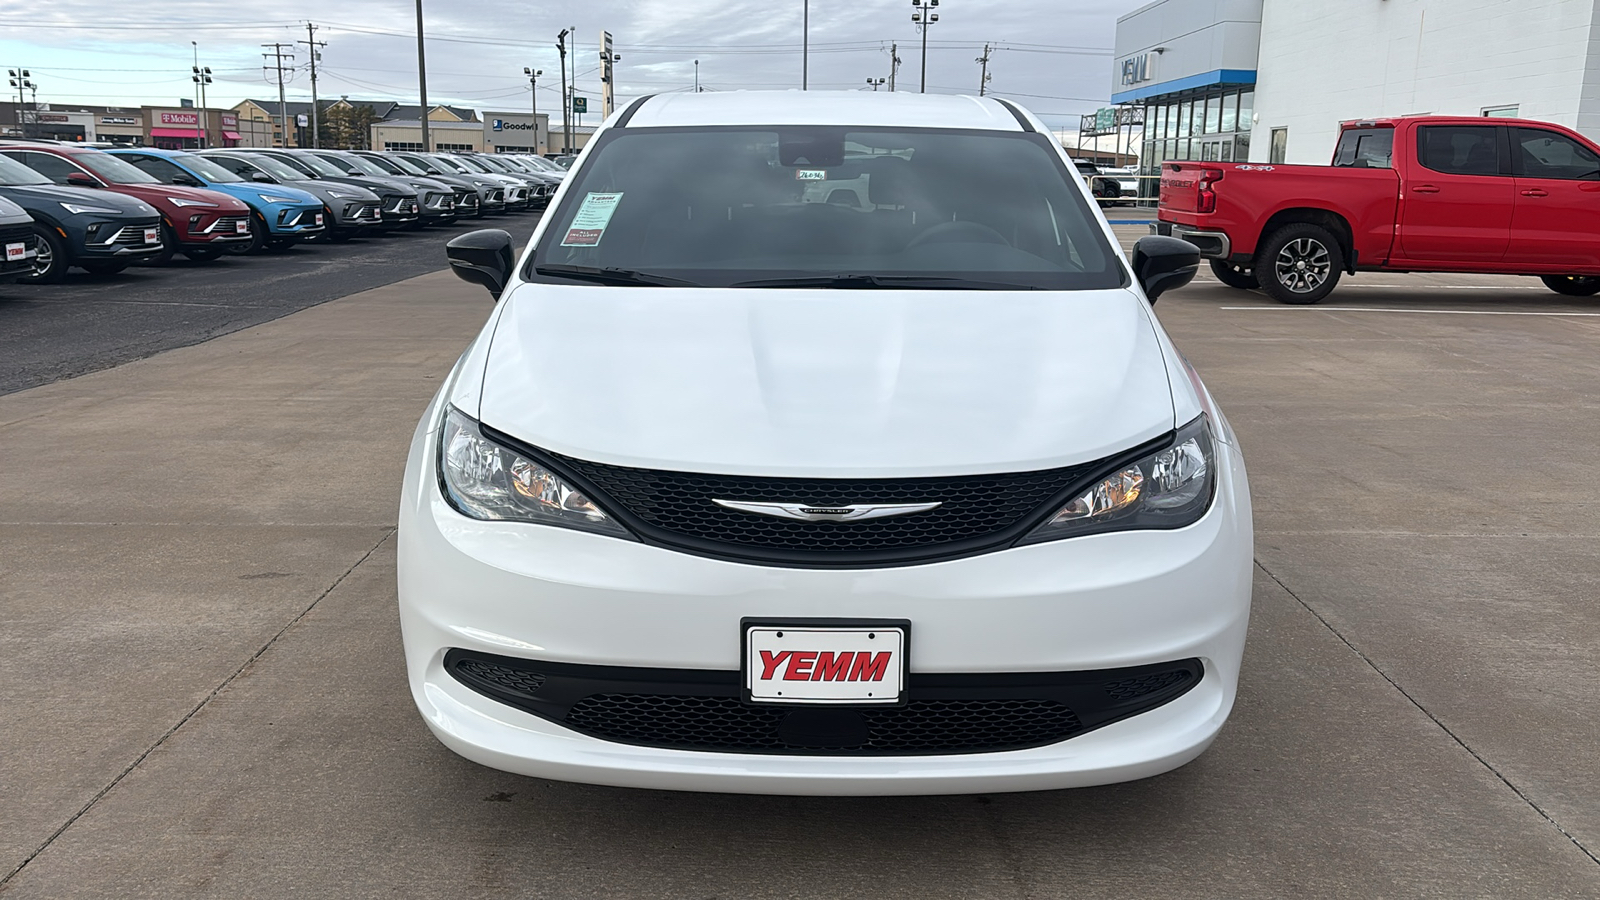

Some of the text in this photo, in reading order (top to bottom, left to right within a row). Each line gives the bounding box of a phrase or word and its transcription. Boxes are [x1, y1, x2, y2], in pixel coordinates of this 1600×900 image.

[170, 115, 197, 124] Mobile
[503, 122, 538, 131] Goodwil
[759, 650, 893, 682] YEMM
